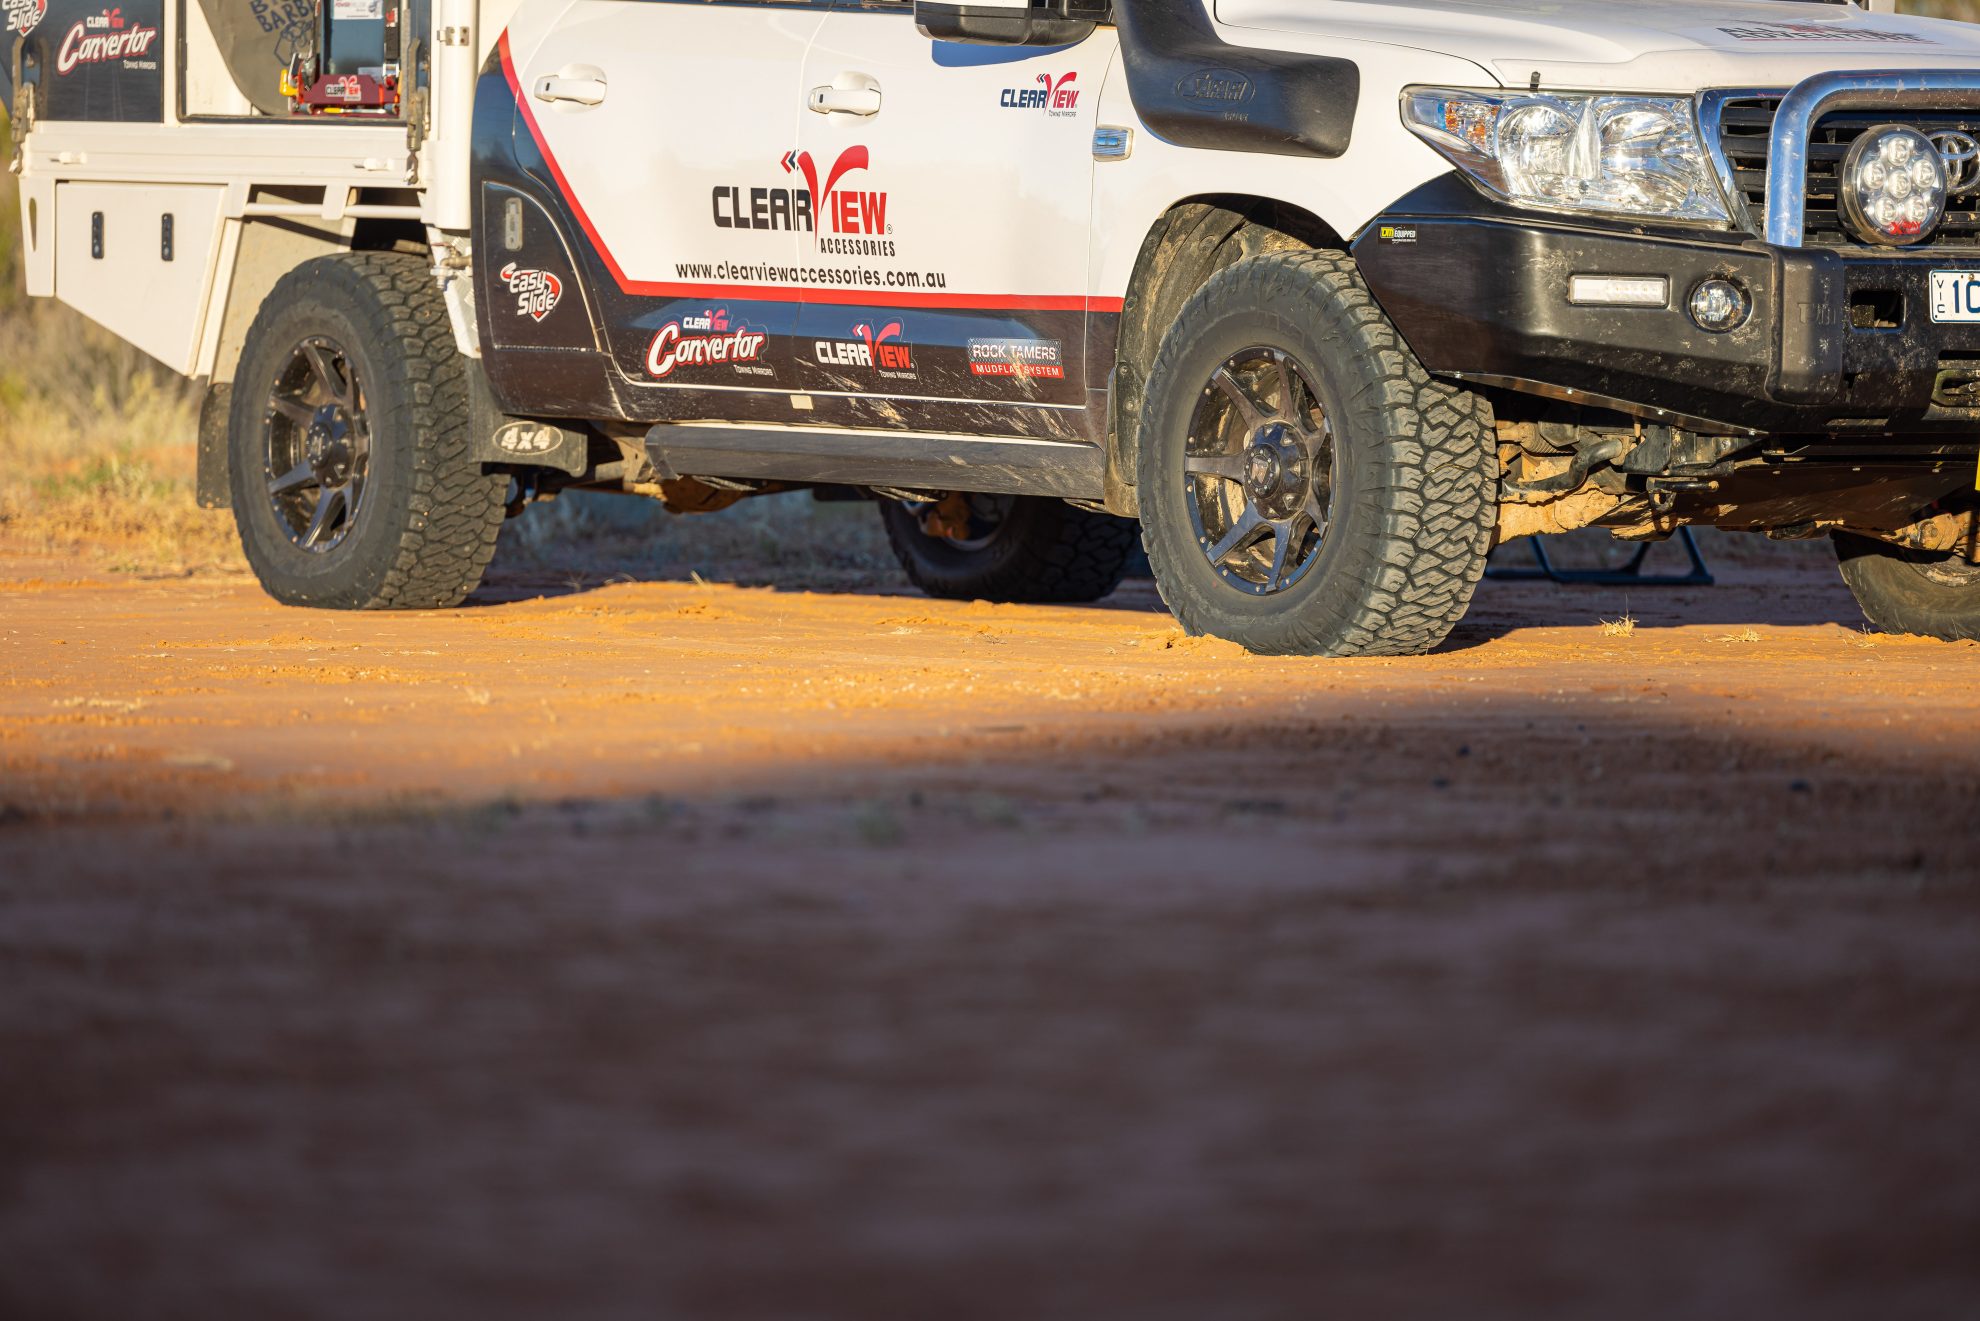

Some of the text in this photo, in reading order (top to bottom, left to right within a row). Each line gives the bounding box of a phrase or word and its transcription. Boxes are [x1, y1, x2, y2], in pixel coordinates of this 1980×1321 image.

[7, 6, 40, 31] Slide
[57, 22, 156, 74] Convertor
[1000, 72, 1080, 115] CLEARVIEW
[712, 145, 887, 252] CLEARVIEW
[820, 237, 896, 257] ACCESSORIES
[510, 270, 547, 294] Easy
[675, 260, 947, 288] www.clearviewaccessories.com.au
[517, 289, 555, 315] Slide
[647, 322, 764, 377] Convertor
[815, 322, 912, 373] CLEARVIEW
[972, 344, 1056, 360] ROCK TAMERS
[1024, 365, 1060, 376] SYSTEM
[501, 427, 551, 449] 4x4
